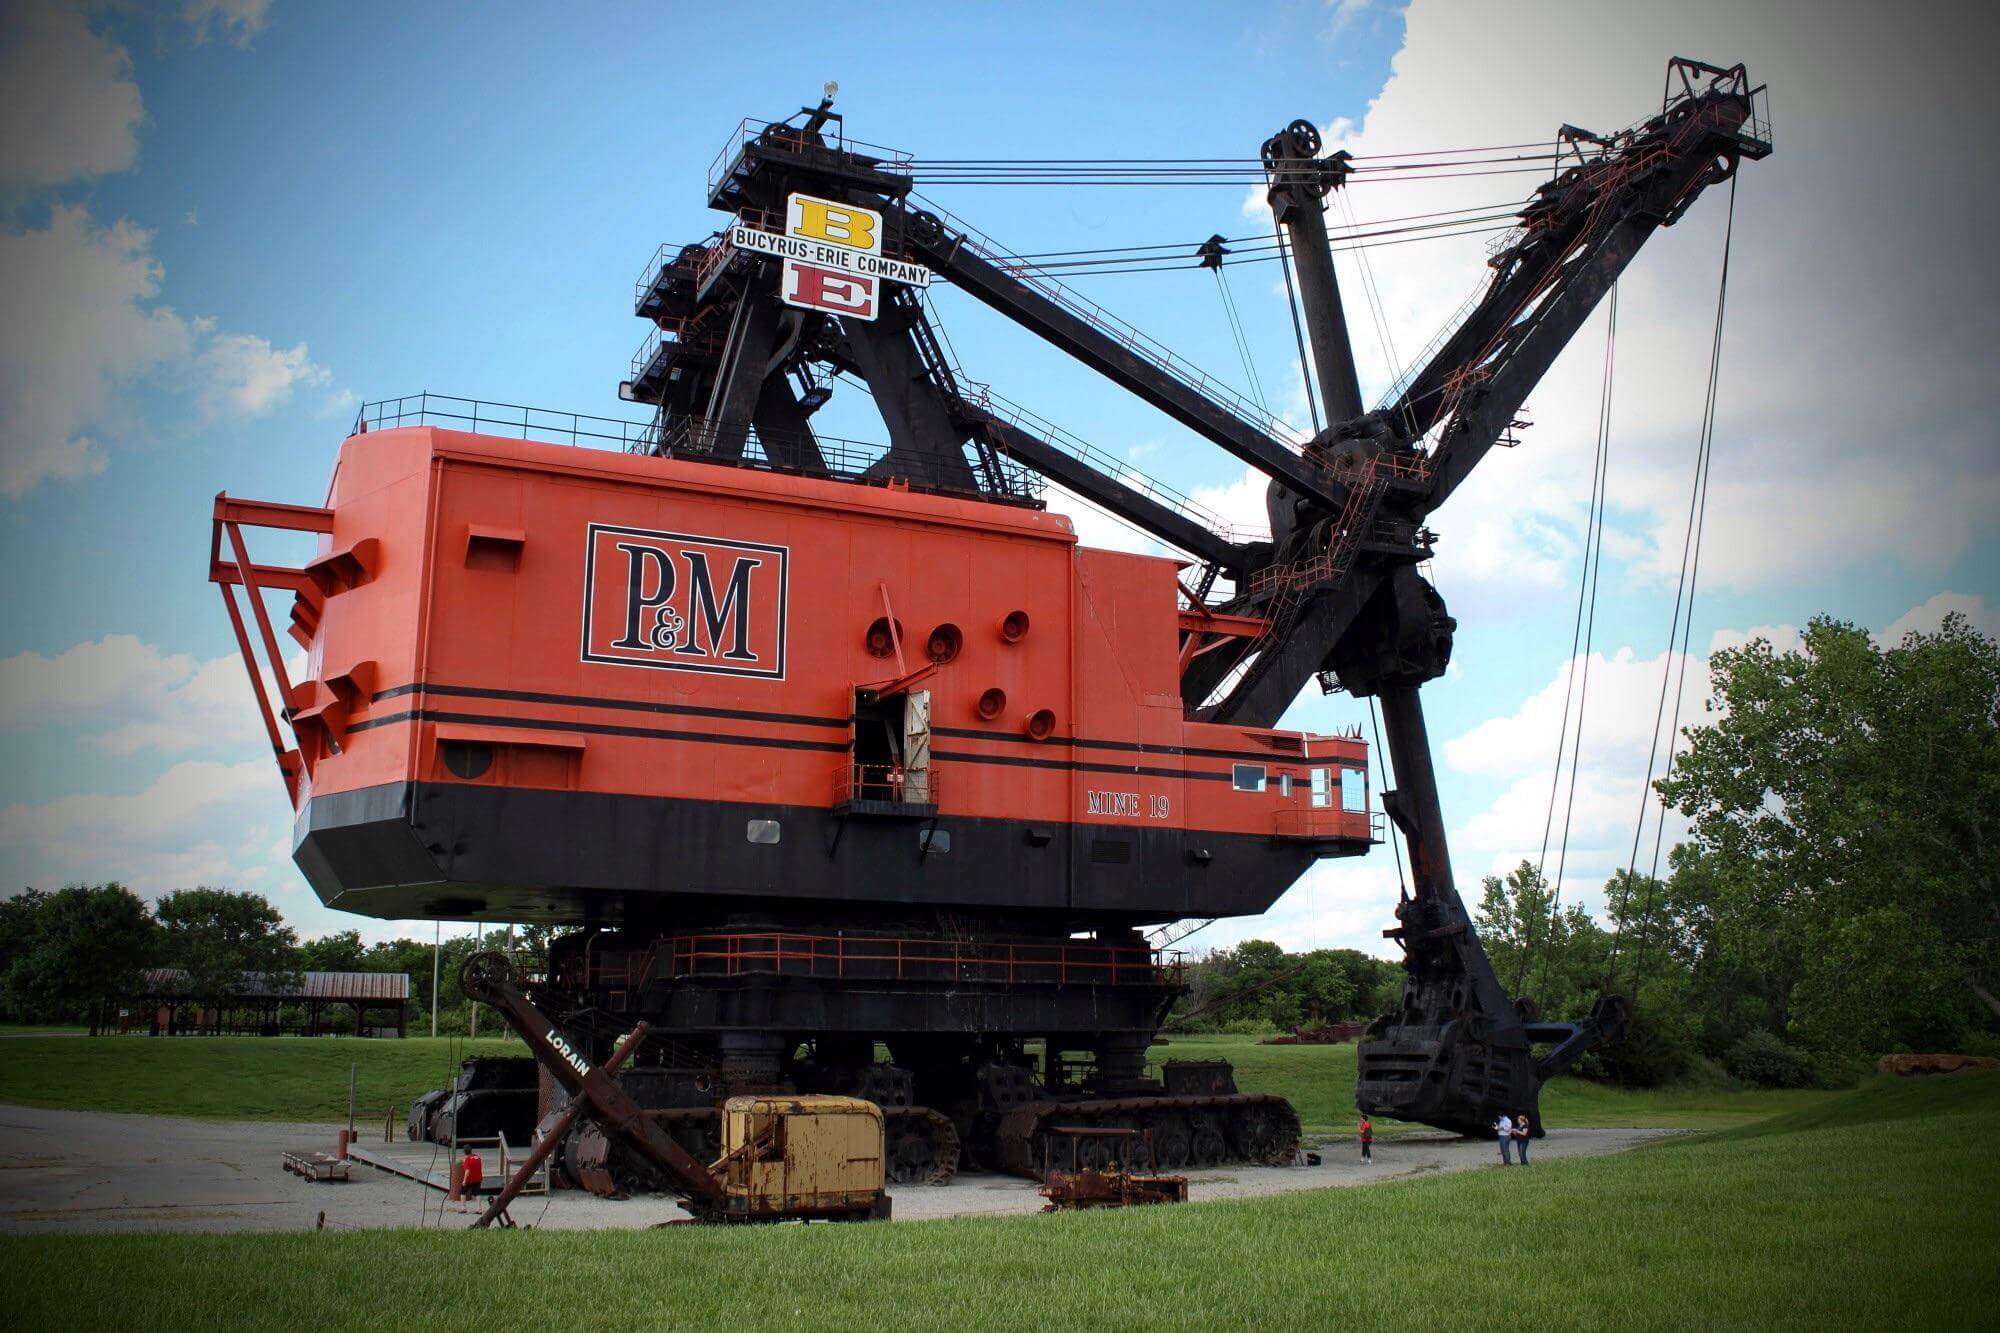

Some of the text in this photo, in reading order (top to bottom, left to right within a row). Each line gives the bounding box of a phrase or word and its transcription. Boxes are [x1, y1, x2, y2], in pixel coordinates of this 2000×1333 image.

[794, 197, 875, 249] B
[735, 230, 928, 284] BUCYRUS-ERIE COMPANY
[789, 263, 872, 316] E
[610, 542, 762, 661] P&M
[1087, 790, 1170, 819] MINE 19
[545, 1029, 590, 1077] LORAIN
